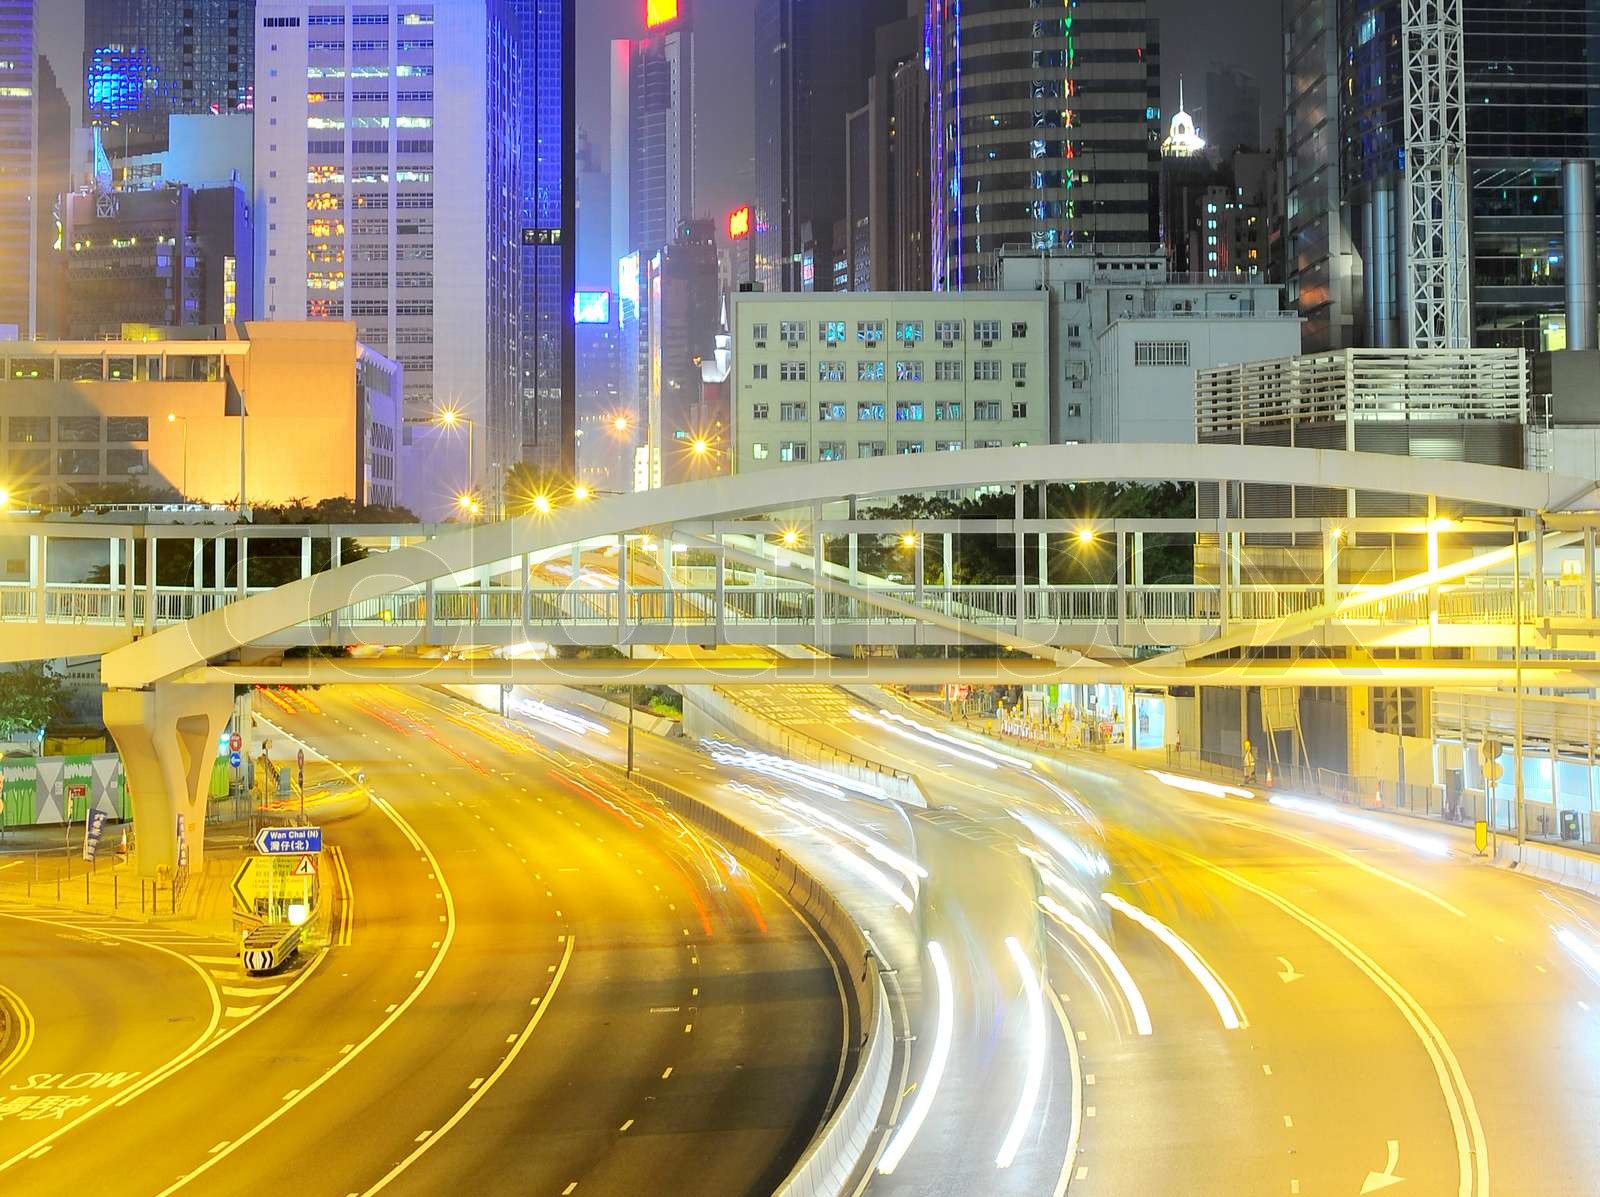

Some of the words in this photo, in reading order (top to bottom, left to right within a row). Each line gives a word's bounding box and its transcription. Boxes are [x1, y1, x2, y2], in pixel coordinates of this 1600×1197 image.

[270, 831, 287, 839] Wan
[288, 830, 306, 839] Chai
[307, 830, 319, 839] (N)
[10, 1071, 142, 1090] SLOW
